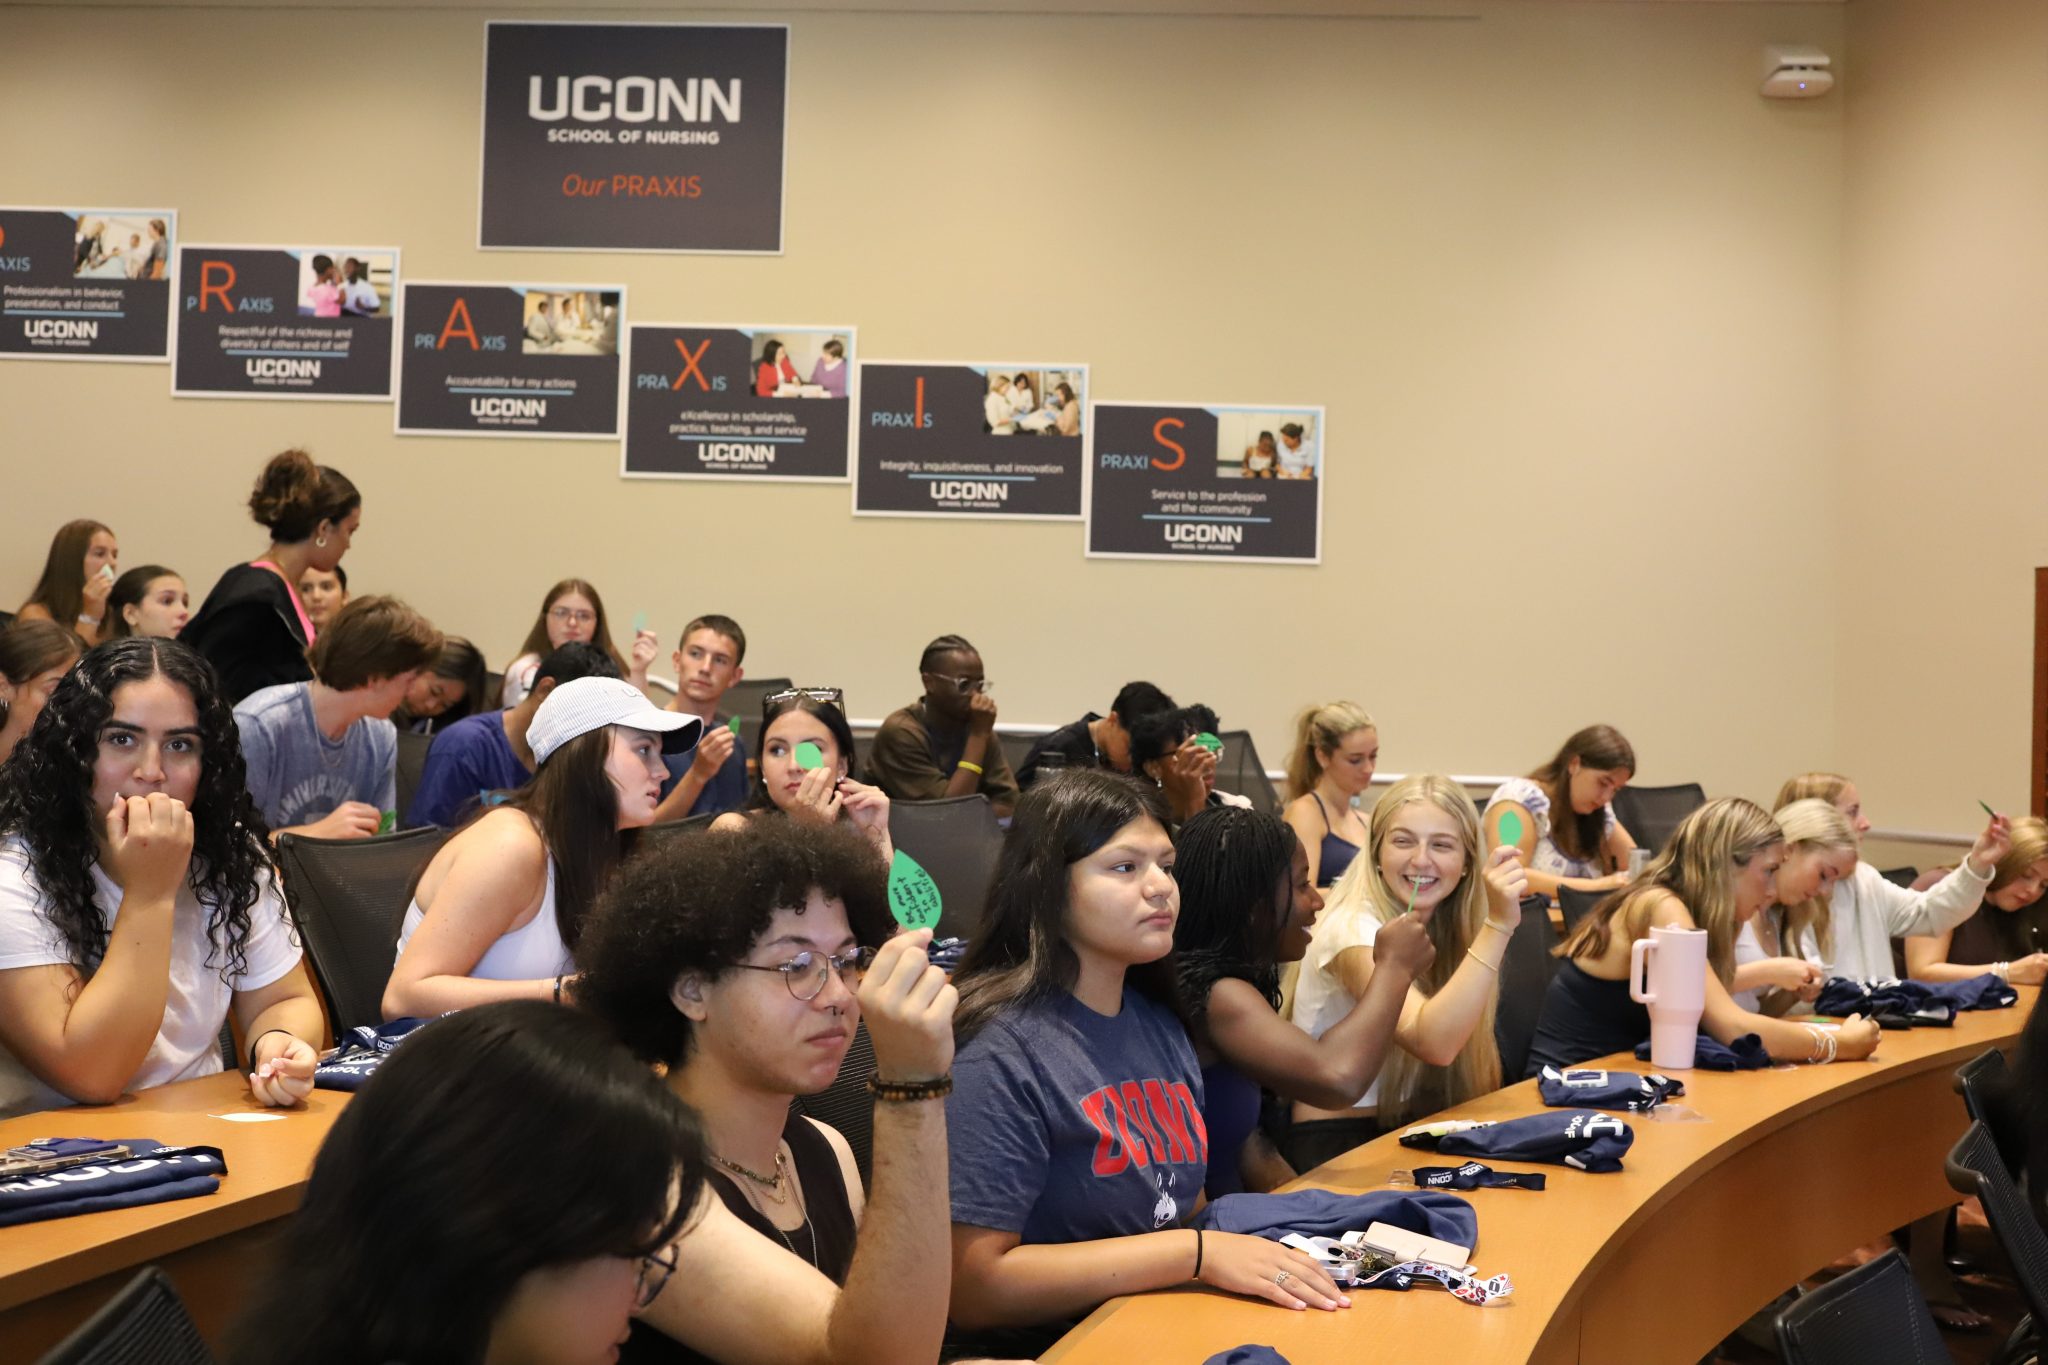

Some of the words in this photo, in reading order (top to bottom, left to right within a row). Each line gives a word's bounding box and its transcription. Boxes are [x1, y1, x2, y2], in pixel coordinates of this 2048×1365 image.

[529, 75, 741, 123] UCONN
[548, 129, 614, 144] SCHOOL
[618, 130, 642, 144] OF
[646, 131, 720, 145] NURSING
[563, 174, 605, 196] Our
[613, 175, 702, 197] PRAXIS
[4, 285, 71, 297] Professionalism
[74, 288, 81, 296] in
[64, 301, 80, 309] and
[83, 301, 119, 310] conduct
[25, 320, 97, 339] UCONN
[219, 325, 266, 337] Respectful
[268, 326, 278, 337] of
[279, 326, 293, 337] the
[296, 327, 332, 338] richness
[335, 328, 352, 338] and
[221, 339, 258, 350] diversity
[261, 340, 270, 349] of
[272, 340, 300, 349] others
[302, 341, 319, 350] and
[321, 341, 331, 350] of
[334, 341, 350, 350] self
[246, 359, 321, 378] UCONN
[446, 375, 509, 387] Accountability
[512, 377, 524, 386] for
[527, 379, 541, 388] my
[544, 379, 577, 388] actions
[471, 398, 546, 417] UCONN
[732, 412, 740, 421] in
[755, 426, 772, 435] and
[774, 427, 806, 436] service
[699, 443, 774, 462] UCONN
[994, 463, 1012, 473] and
[1015, 463, 1063, 474] innovation
[930, 481, 1008, 500] UCONN
[1151, 489, 1185, 500] Service
[1188, 490, 1198, 500] to
[1201, 490, 1215, 500] the
[1218, 491, 1267, 502] profession
[1161, 503, 1179, 513] and
[1182, 503, 1197, 513] the
[1199, 505, 1252, 516] community
[1164, 524, 1242, 543] UCONN
